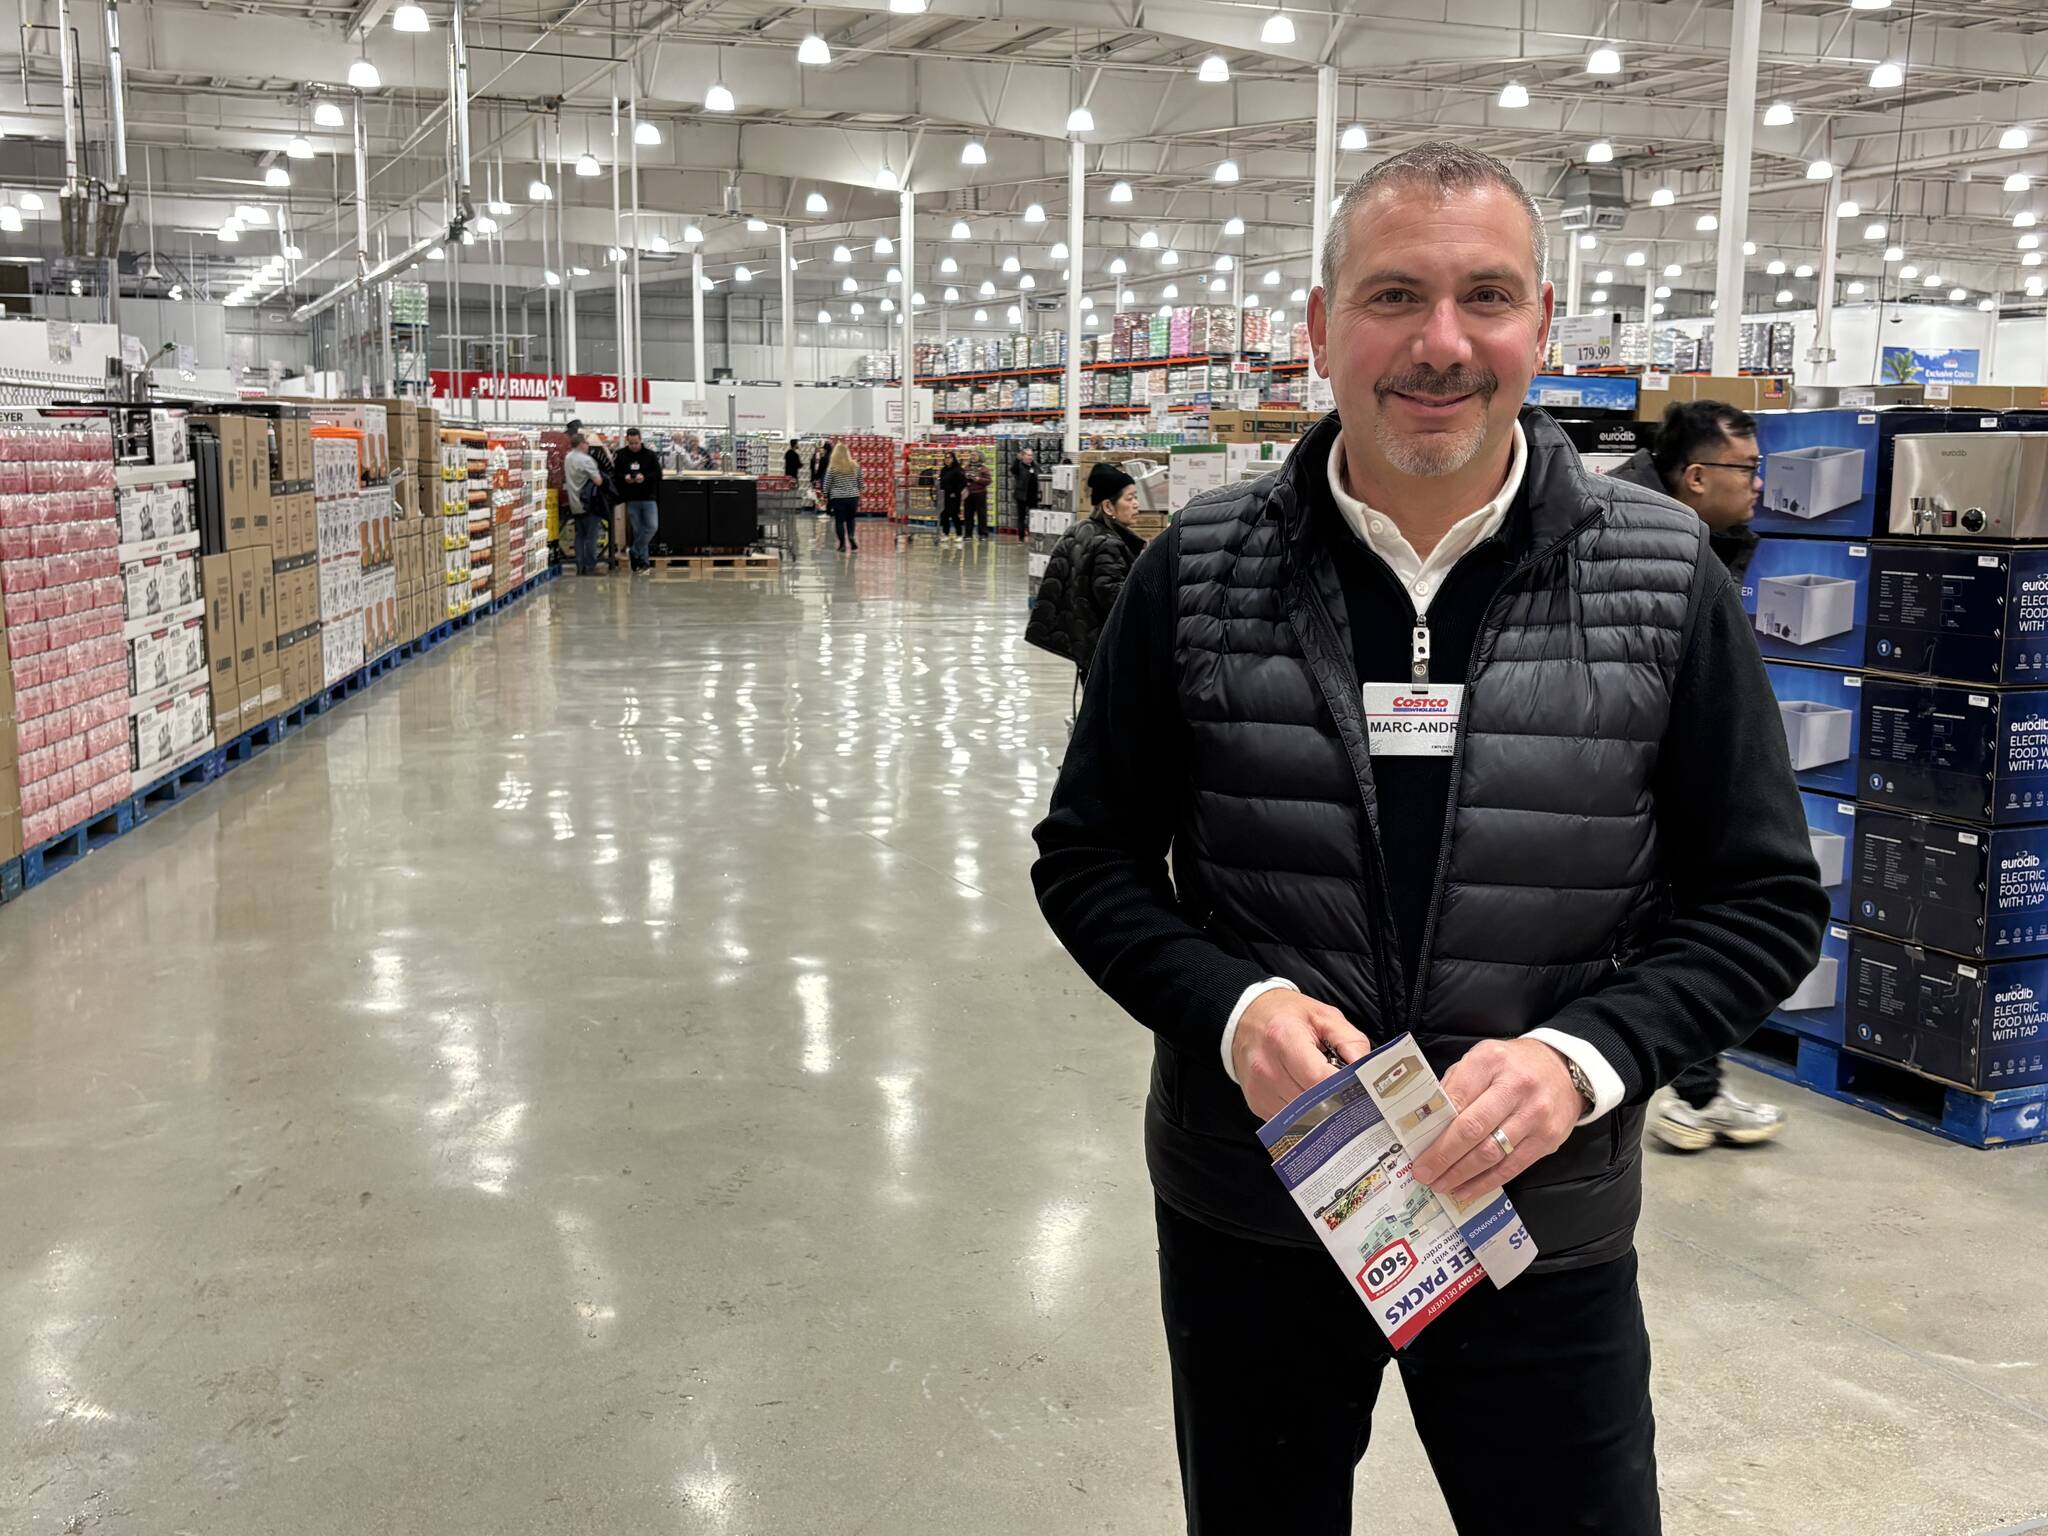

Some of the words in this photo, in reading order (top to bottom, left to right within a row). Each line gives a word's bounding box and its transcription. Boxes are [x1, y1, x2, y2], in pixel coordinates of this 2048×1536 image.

[1578, 346, 1610, 361] 179.99
[479, 378, 564, 397] PHARMACY
[1599, 431, 1636, 441] eurodib
[2019, 620, 2045, 631] WITH
[2009, 747, 2039, 759] FOOD
[2009, 760, 2034, 771] WITH
[2001, 855, 2040, 869] eurodib
[2000, 870, 2046, 884] ELECTRIC
[2000, 883, 2028, 896] FOOD
[1999, 896, 2024, 908] WITH
[2026, 894, 2045, 906] TAP
[1995, 988, 2033, 1003] eurodib
[1994, 1001, 2039, 1017] ELECTRIC
[1993, 1016, 2021, 1029] FOOD
[2024, 1012, 2048, 1025] WAR
[1992, 1028, 2017, 1041] WITH
[2020, 1025, 2038, 1037] TAP
[1468, 1215, 1498, 1239] SAVINGS
[1432, 1250, 1449, 1265] with
[1367, 1251, 1408, 1287] $60
[1385, 1266, 1448, 1325] PACKS
[1427, 1289, 1458, 1316] DELIVERY
